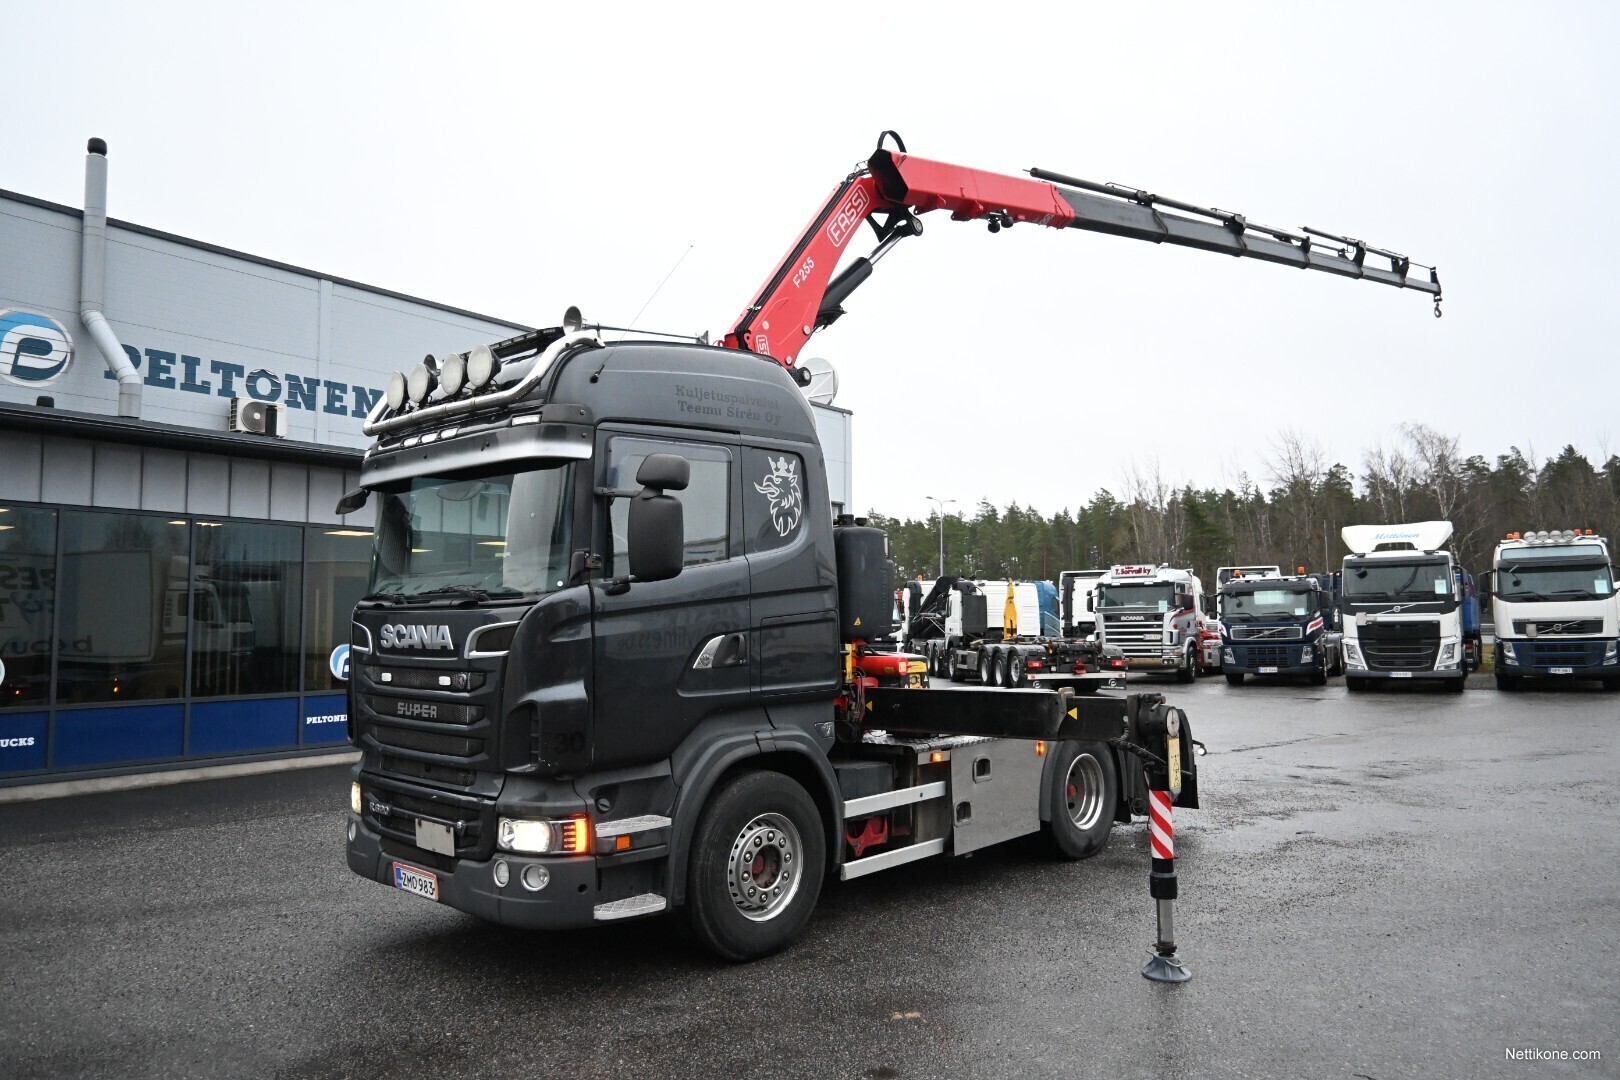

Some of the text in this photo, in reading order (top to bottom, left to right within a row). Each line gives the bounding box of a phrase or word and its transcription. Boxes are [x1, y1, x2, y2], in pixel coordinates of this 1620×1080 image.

[829, 188, 867, 242] FASSI
[792, 256, 815, 289] F255
[677, 399, 722, 416] Teemu
[764, 411, 782, 427] Oy
[380, 623, 454, 650] SCANIA
[306, 714, 348, 725] PELTONE
[397, 702, 437, 719] SUPER
[0, 737, 35, 748] UCKS
